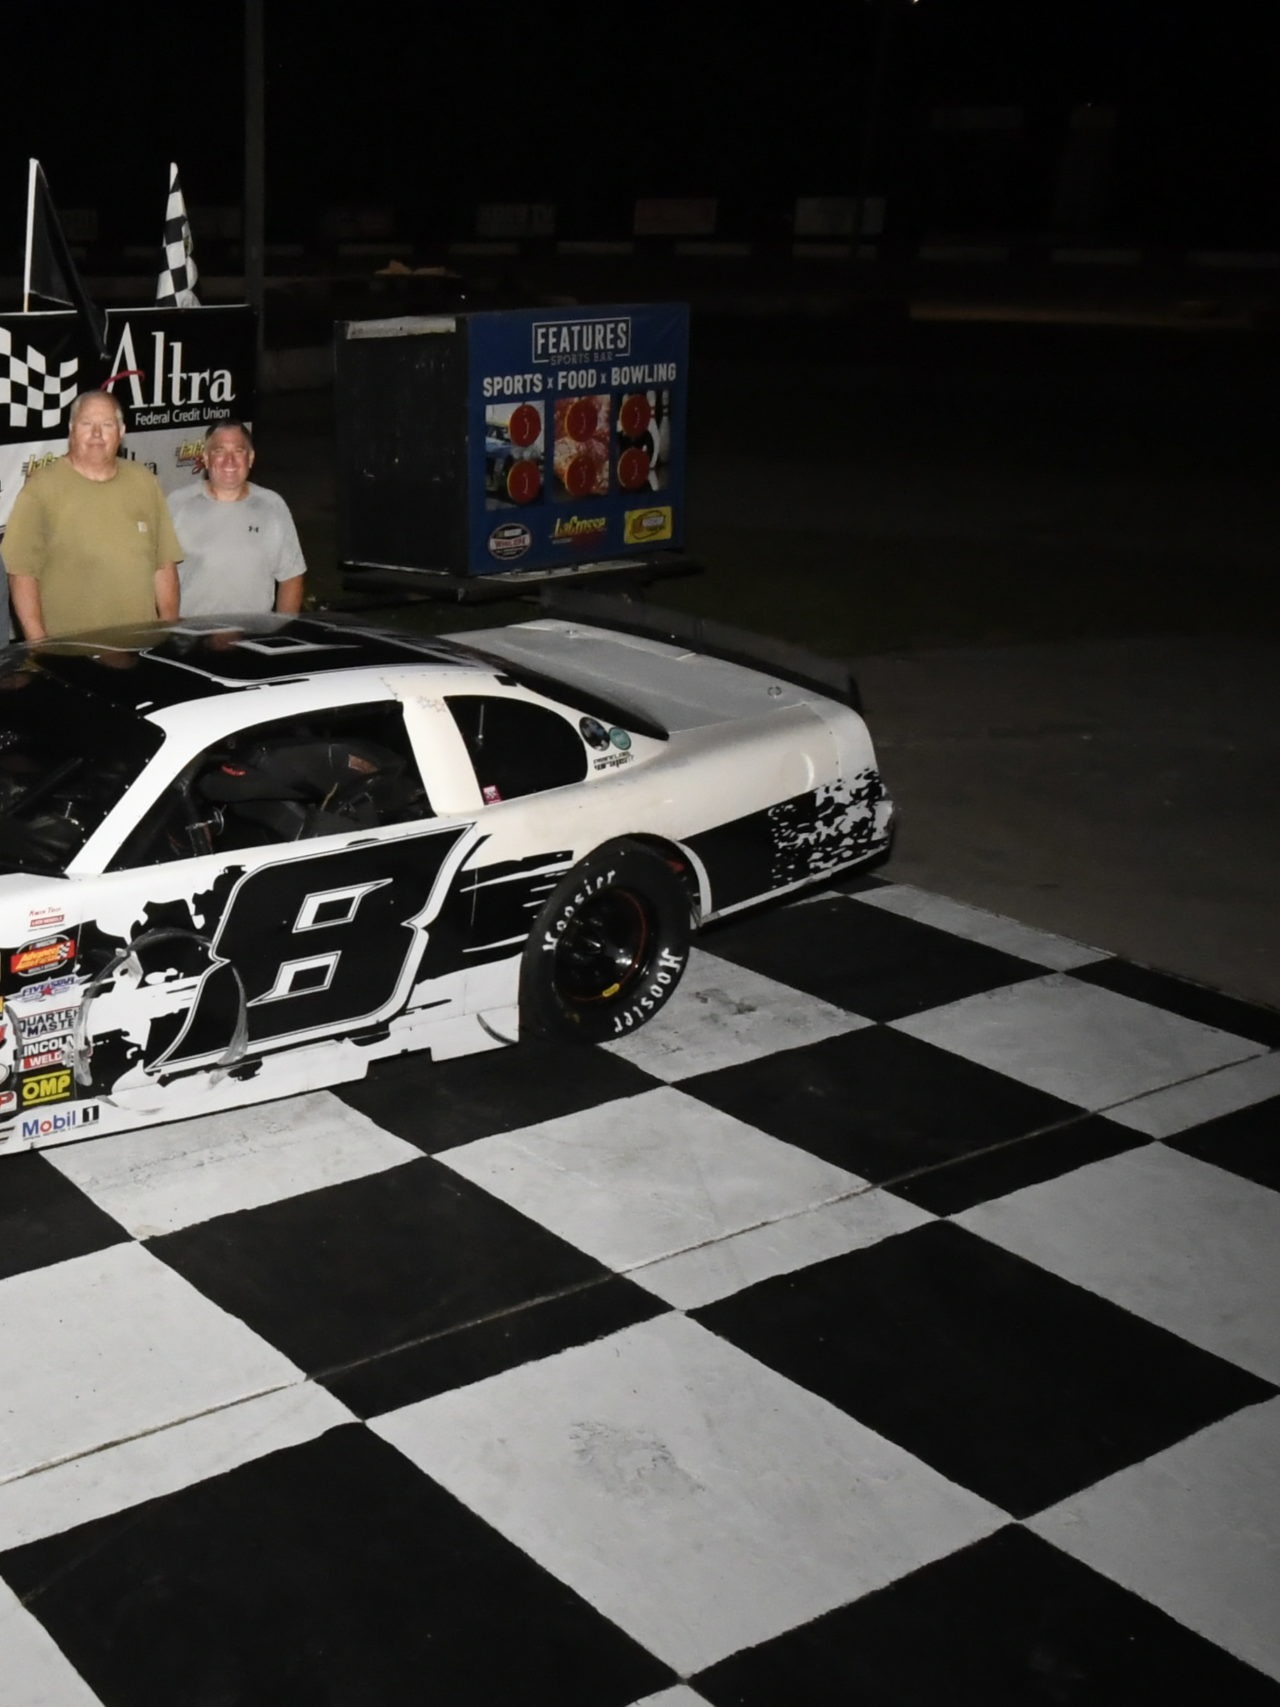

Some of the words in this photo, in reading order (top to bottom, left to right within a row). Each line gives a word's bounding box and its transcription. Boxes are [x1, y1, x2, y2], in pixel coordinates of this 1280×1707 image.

[536, 322, 628, 355] FEATURES
[107, 321, 236, 409] Altra
[550, 353, 590, 366] SPORTS
[593, 351, 613, 362] BAR
[483, 374, 543, 398] SPORTS
[558, 369, 597, 390] FOOD
[611, 362, 677, 386] BOWLING
[135, 410, 170, 426] Federal
[172, 408, 201, 423] Credit
[203, 406, 231, 420] Union
[145, 822, 477, 1072] 8
[27, 1018, 75, 1037] MASTE
[22, 1074, 71, 1099] OMP
[22, 1110, 76, 1137] Mobil
